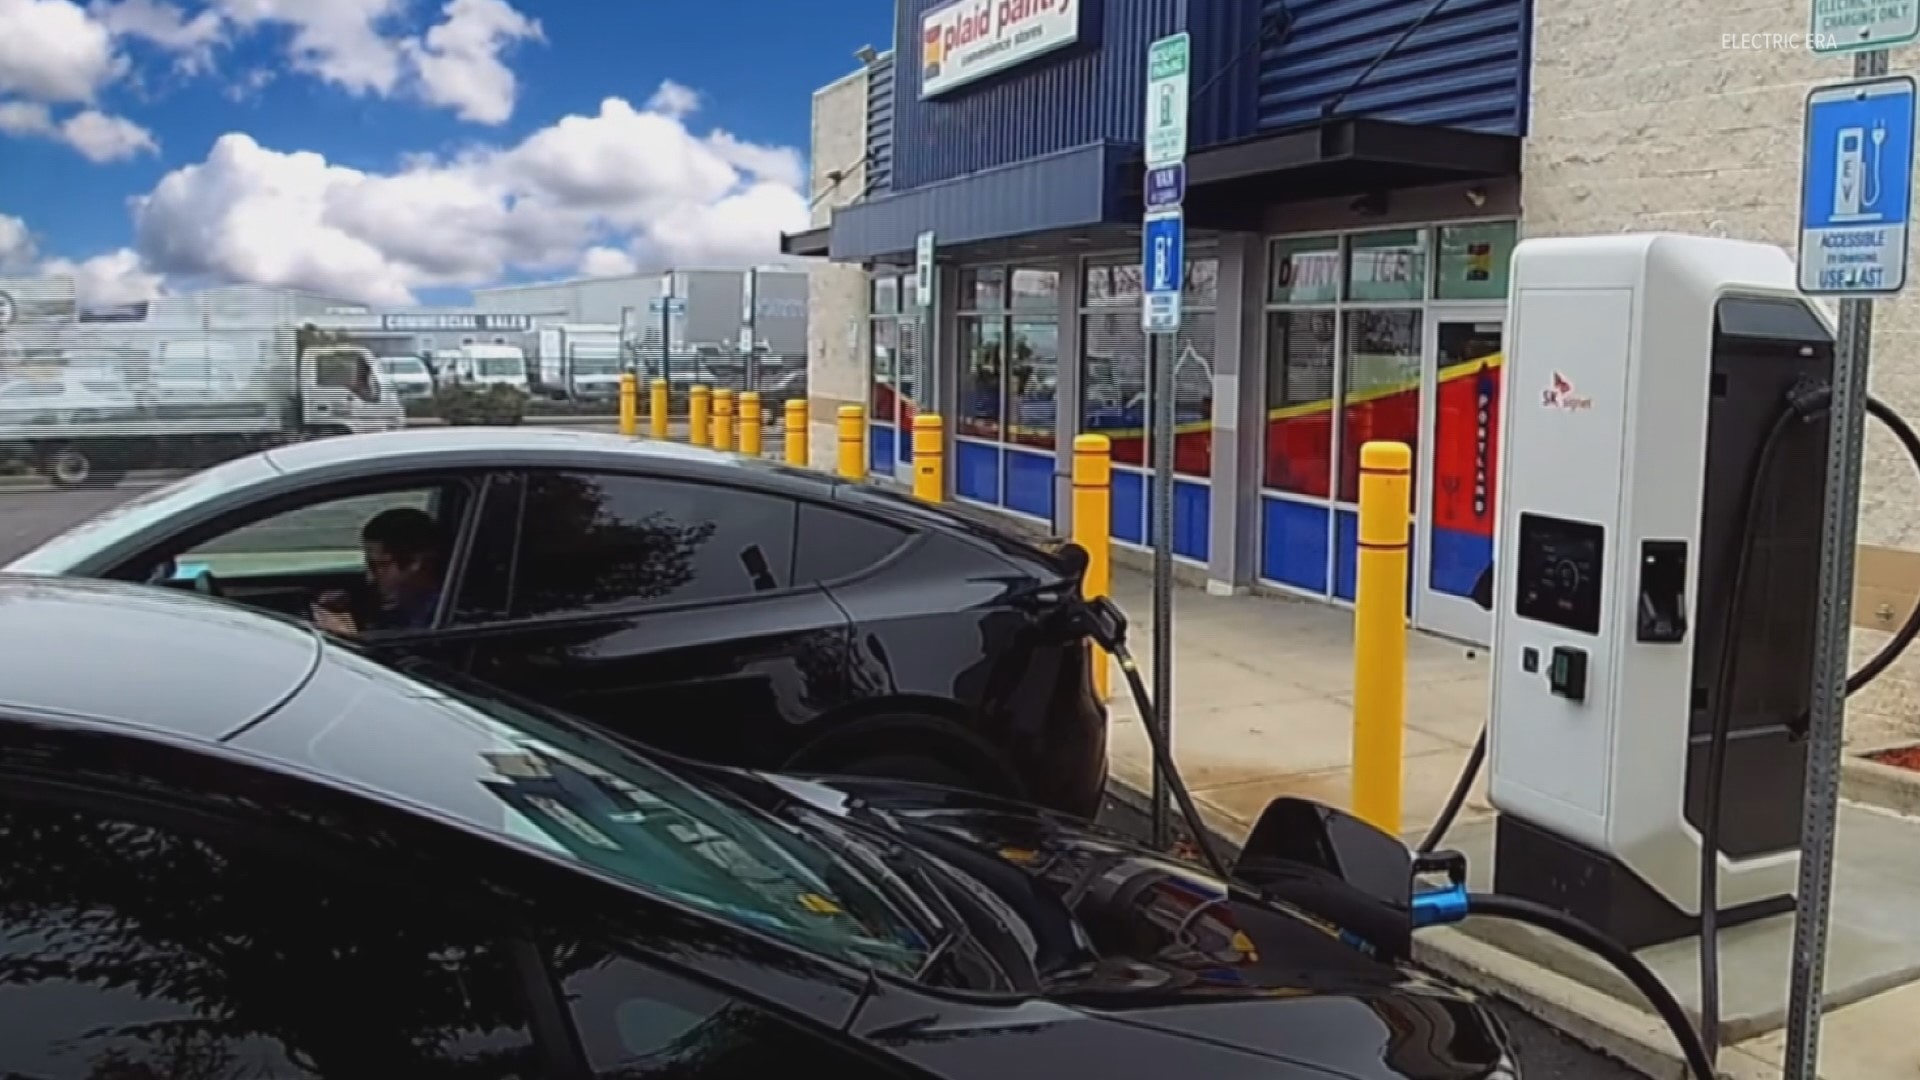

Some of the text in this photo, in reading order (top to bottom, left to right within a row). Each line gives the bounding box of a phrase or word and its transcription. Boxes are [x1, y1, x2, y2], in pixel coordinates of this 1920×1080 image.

[943, 0, 991, 61] plaid
[1014, 24, 1043, 44] stores
[1820, 230, 1885, 249] ACCESSIBLE
[1278, 250, 1408, 288] DAIRY ICE
[1819, 268, 1844, 289] USE
[1542, 389, 1559, 408] SK
[1475, 394, 1489, 512] PORTLAND
